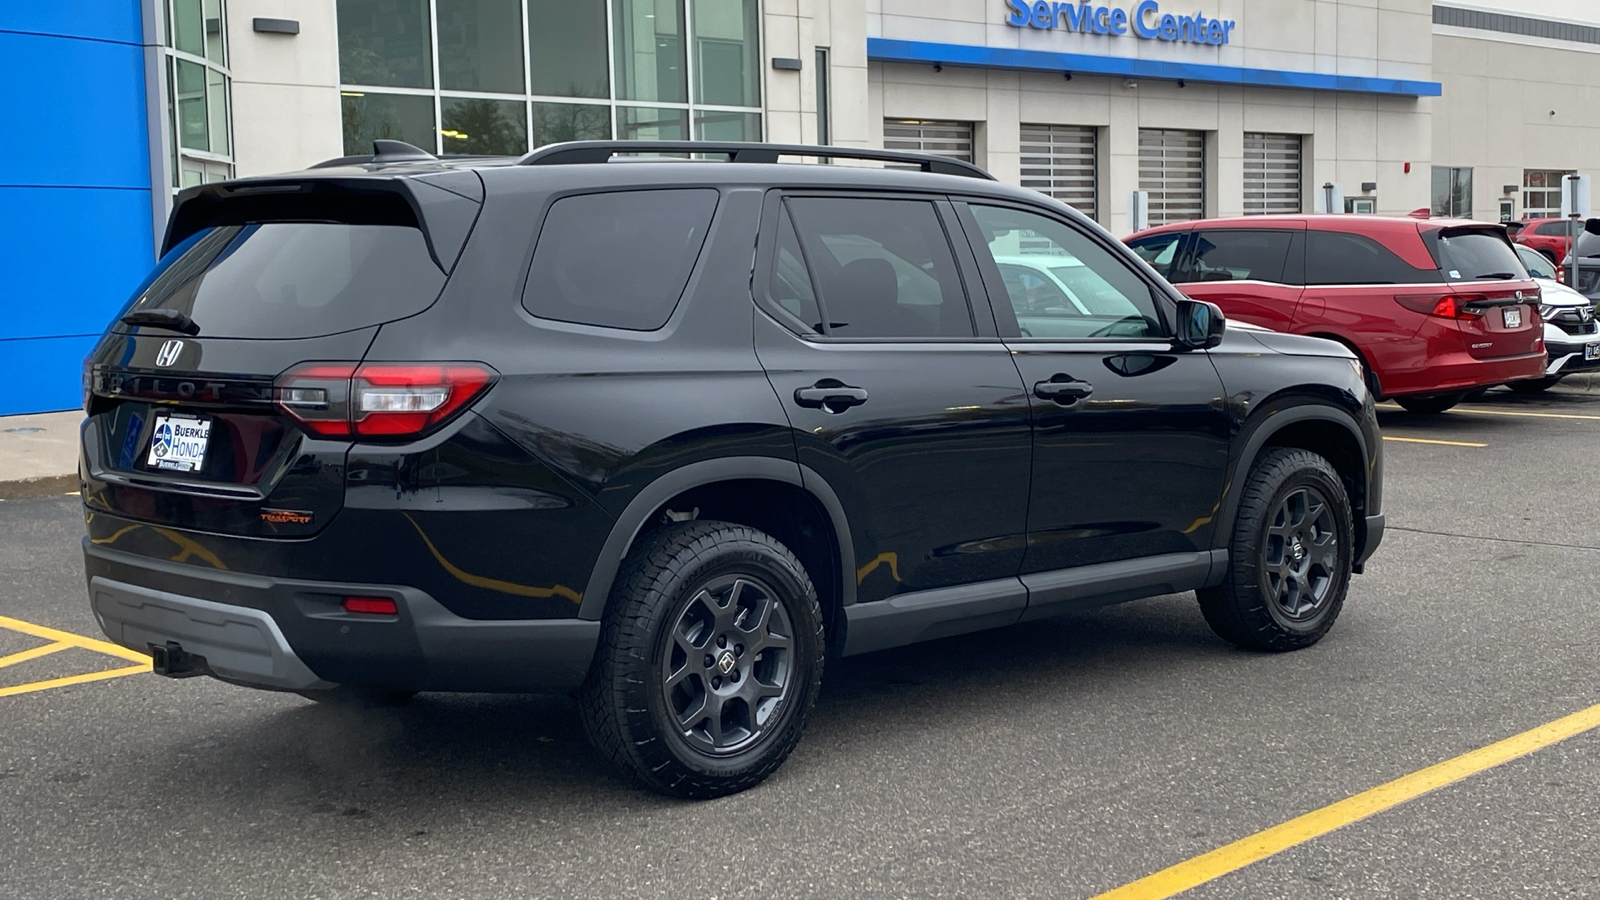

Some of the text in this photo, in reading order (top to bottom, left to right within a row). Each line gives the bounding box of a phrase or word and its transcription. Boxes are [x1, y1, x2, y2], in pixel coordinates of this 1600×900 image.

[1006, 0, 1236, 45] Service Center
[175, 425, 209, 438] BUERKLE
[171, 438, 205, 458] HONDA
